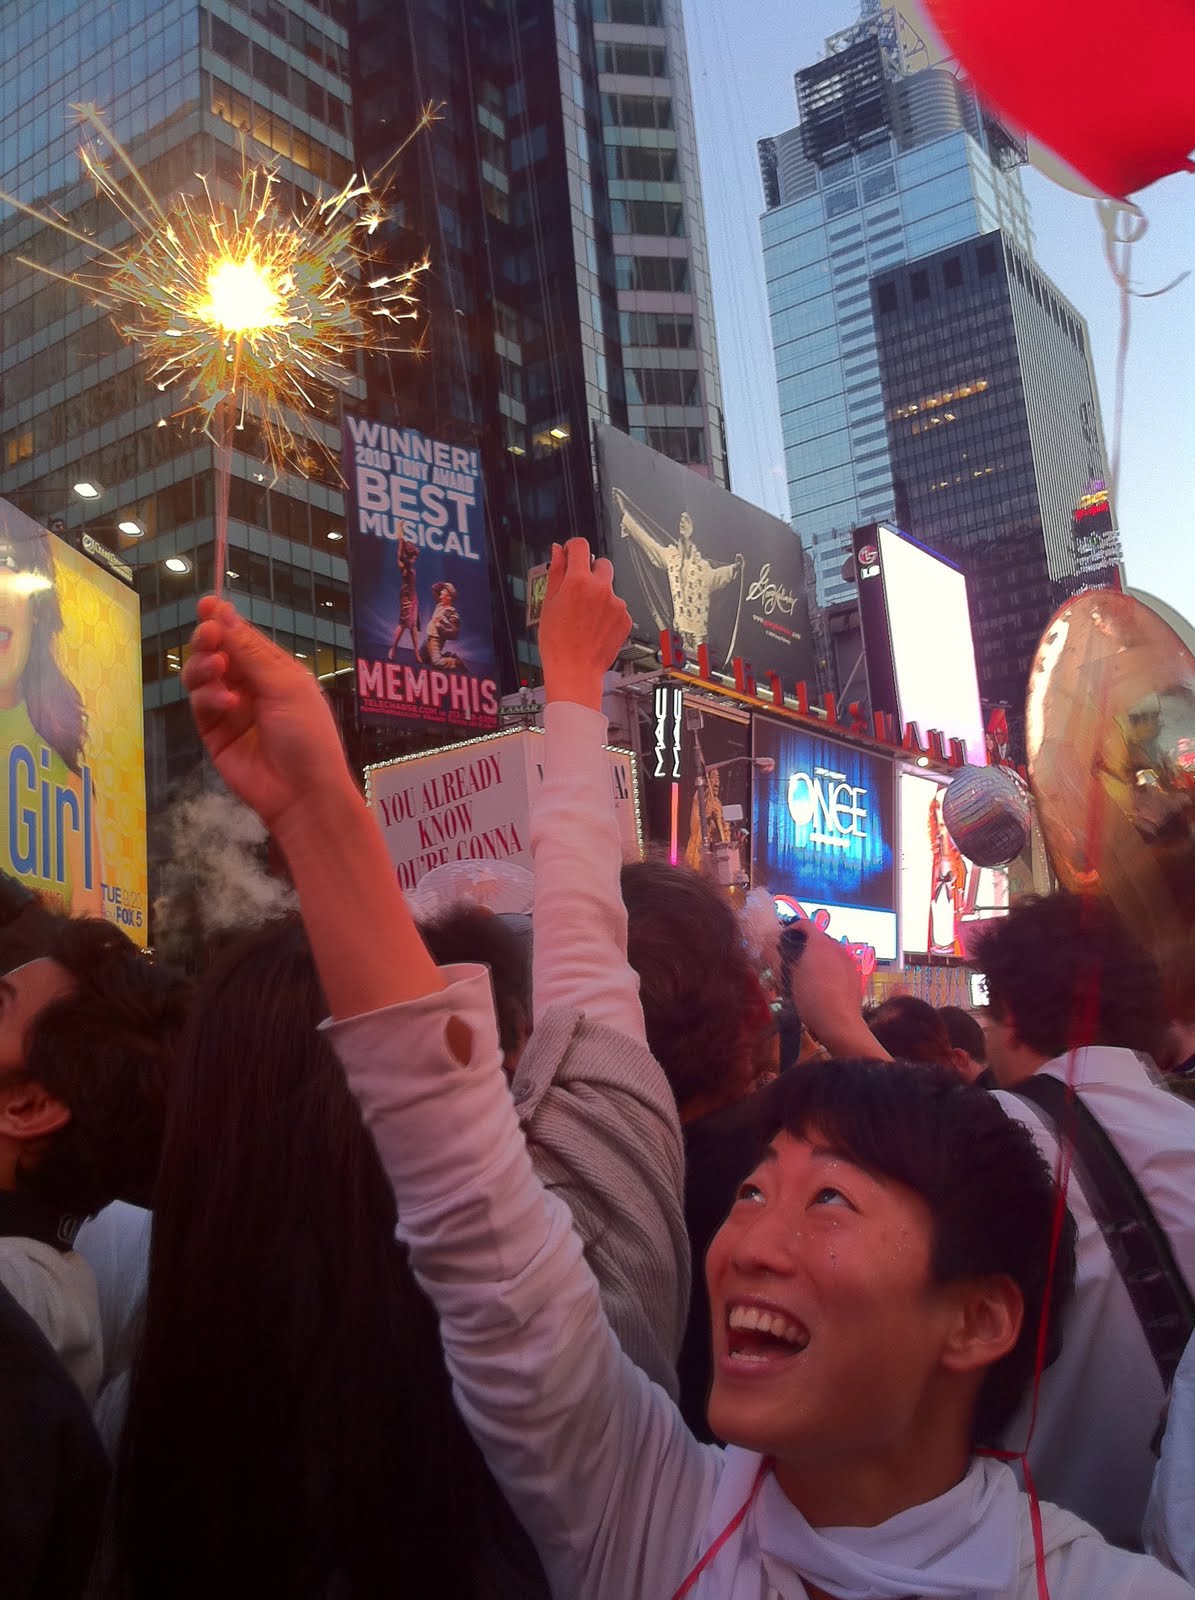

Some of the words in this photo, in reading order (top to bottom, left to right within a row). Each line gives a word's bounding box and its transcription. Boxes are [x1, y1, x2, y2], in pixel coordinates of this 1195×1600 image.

[347, 416, 478, 476] WINNER!
[356, 445, 391, 471] 2010
[394, 455, 429, 481] TONY
[432, 466, 475, 493] AWARD
[356, 466, 476, 533] BEST
[359, 509, 480, 560] MUSICAL
[358, 657, 499, 716] MEMPHIS
[8, 744, 94, 891] Girl
[379, 786, 417, 828] YOU
[421, 751, 505, 810] ALREADY
[787, 772, 868, 839] ONCE
[417, 800, 474, 850] KNOW
[101, 882, 122, 905] TUE
[115, 905, 136, 928] FOX
[136, 911, 143, 928] 5
